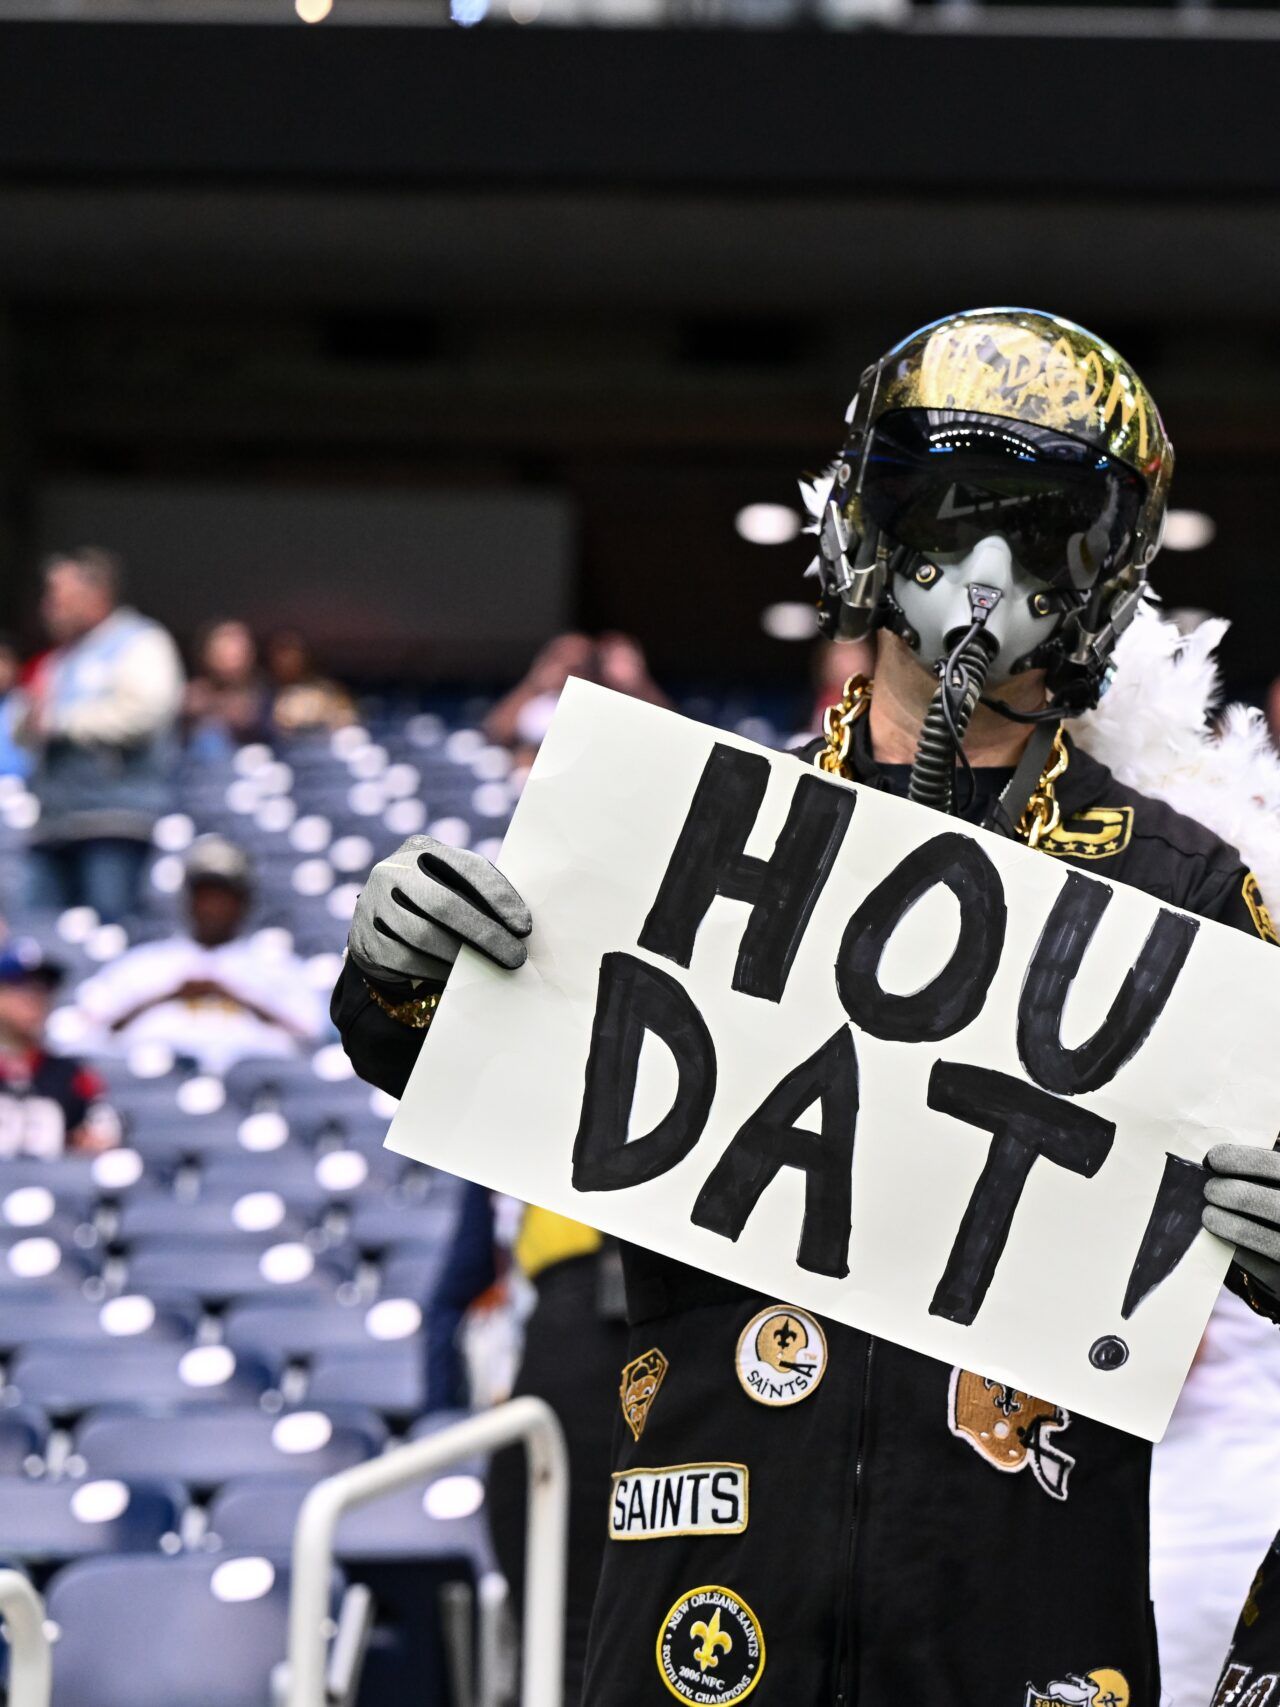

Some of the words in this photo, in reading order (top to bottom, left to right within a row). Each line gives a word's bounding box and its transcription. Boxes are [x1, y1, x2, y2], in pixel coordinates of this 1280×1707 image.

[638, 742, 1200, 1096] HOU
[572, 952, 1207, 1372] DAT!
[747, 1369, 808, 1399] SAINTS
[613, 1471, 739, 1531] SAINTS
[668, 1601, 690, 1631] NEW
[690, 1592, 740, 1615] ORLEANS
[736, 1611, 759, 1658] SAINTS
[663, 1644, 678, 1685] SOUTH
[675, 1679, 694, 1699] DIV.
[694, 1674, 751, 1704] CHAMPIONS
[679, 1665, 701, 1683] 2006
[701, 1673, 726, 1691] NFC
